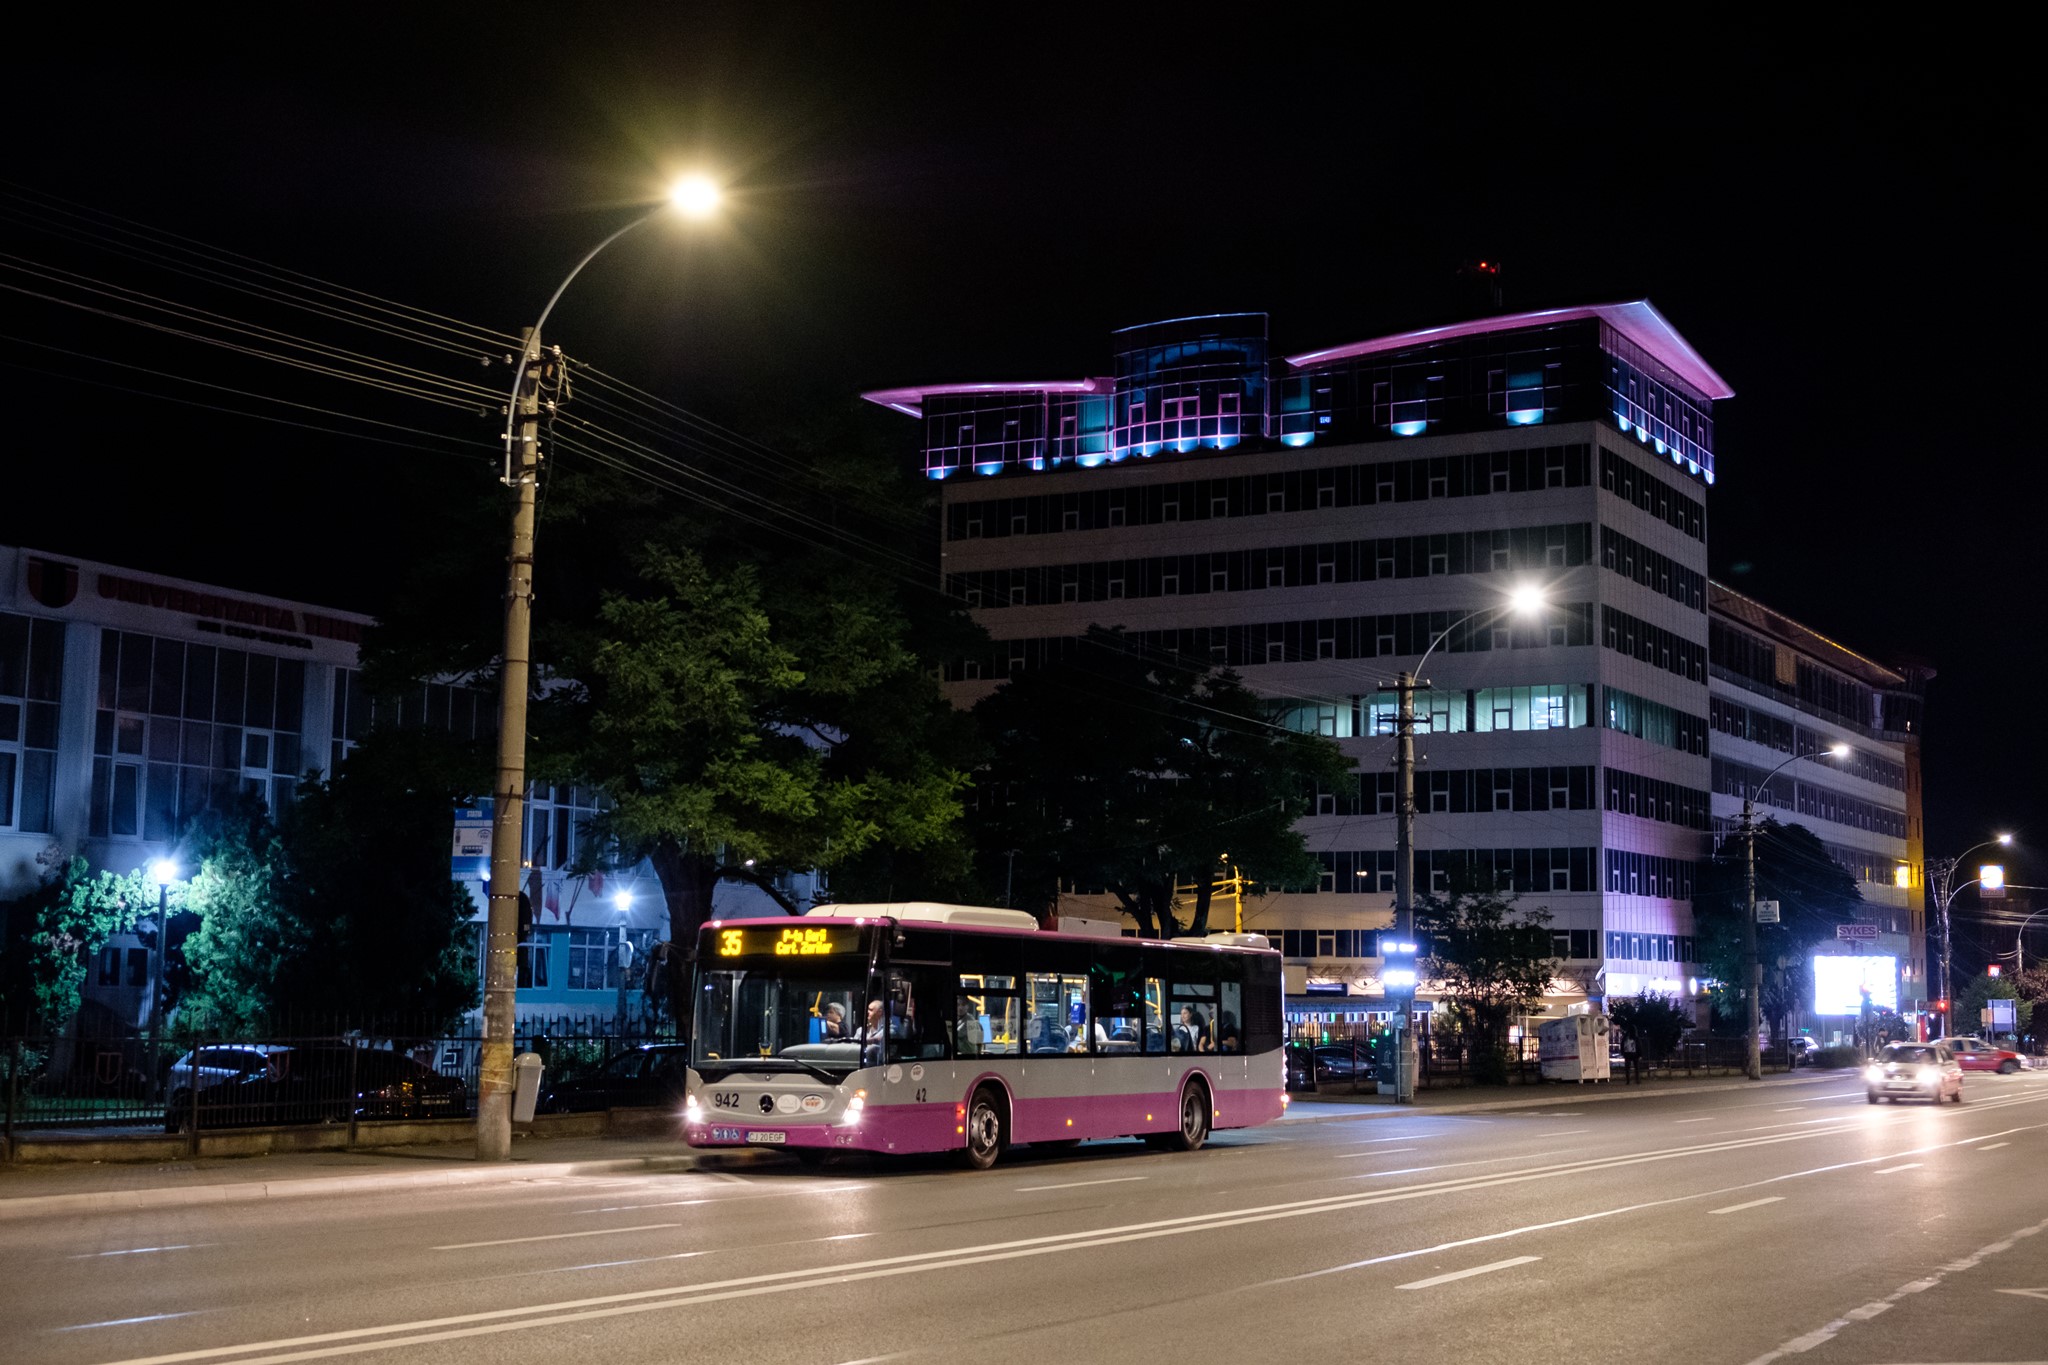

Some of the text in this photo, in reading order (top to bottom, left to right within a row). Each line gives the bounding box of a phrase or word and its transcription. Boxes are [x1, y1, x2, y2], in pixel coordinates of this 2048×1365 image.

[1838, 926, 1876, 935] SYKES
[720, 930, 743, 956] 35
[714, 1092, 740, 1108] 942
[915, 1087, 927, 1104] 42
[749, 1133, 759, 1142] CJ
